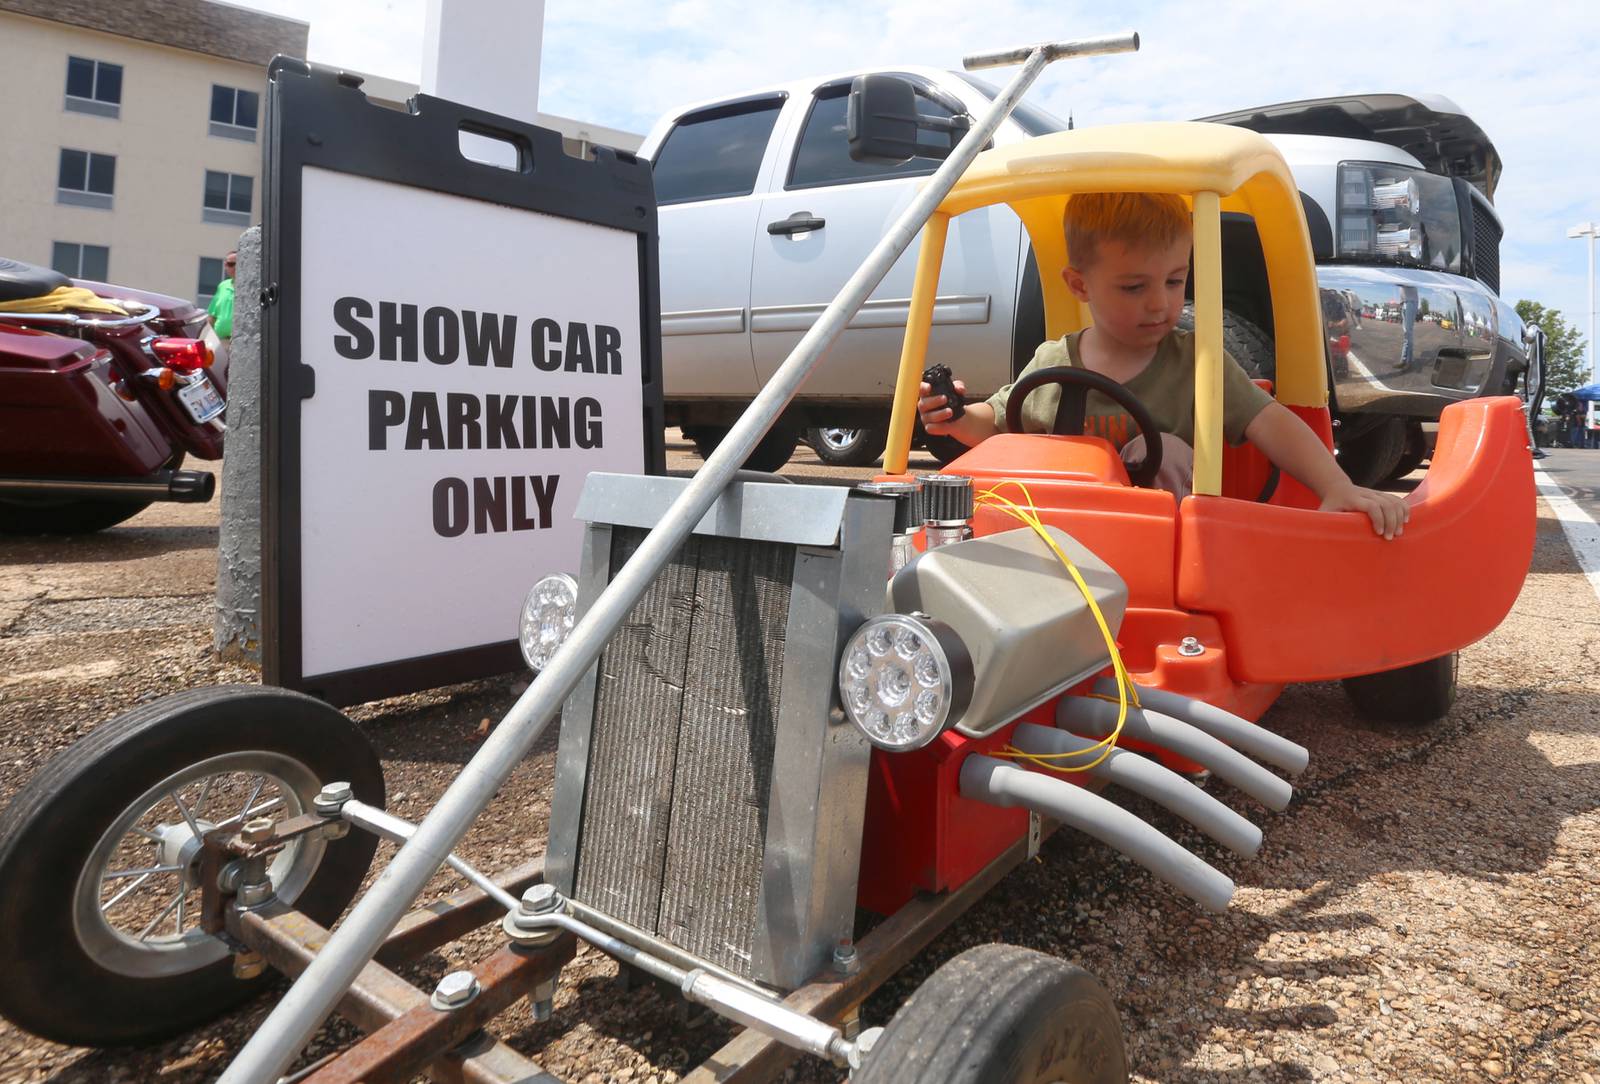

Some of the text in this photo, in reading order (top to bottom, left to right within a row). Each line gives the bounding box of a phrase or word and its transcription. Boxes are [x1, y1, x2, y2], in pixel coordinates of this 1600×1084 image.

[334, 297, 622, 375] SHOW CAR
[369, 390, 603, 451] PARKING
[433, 474, 560, 538] ONLY
